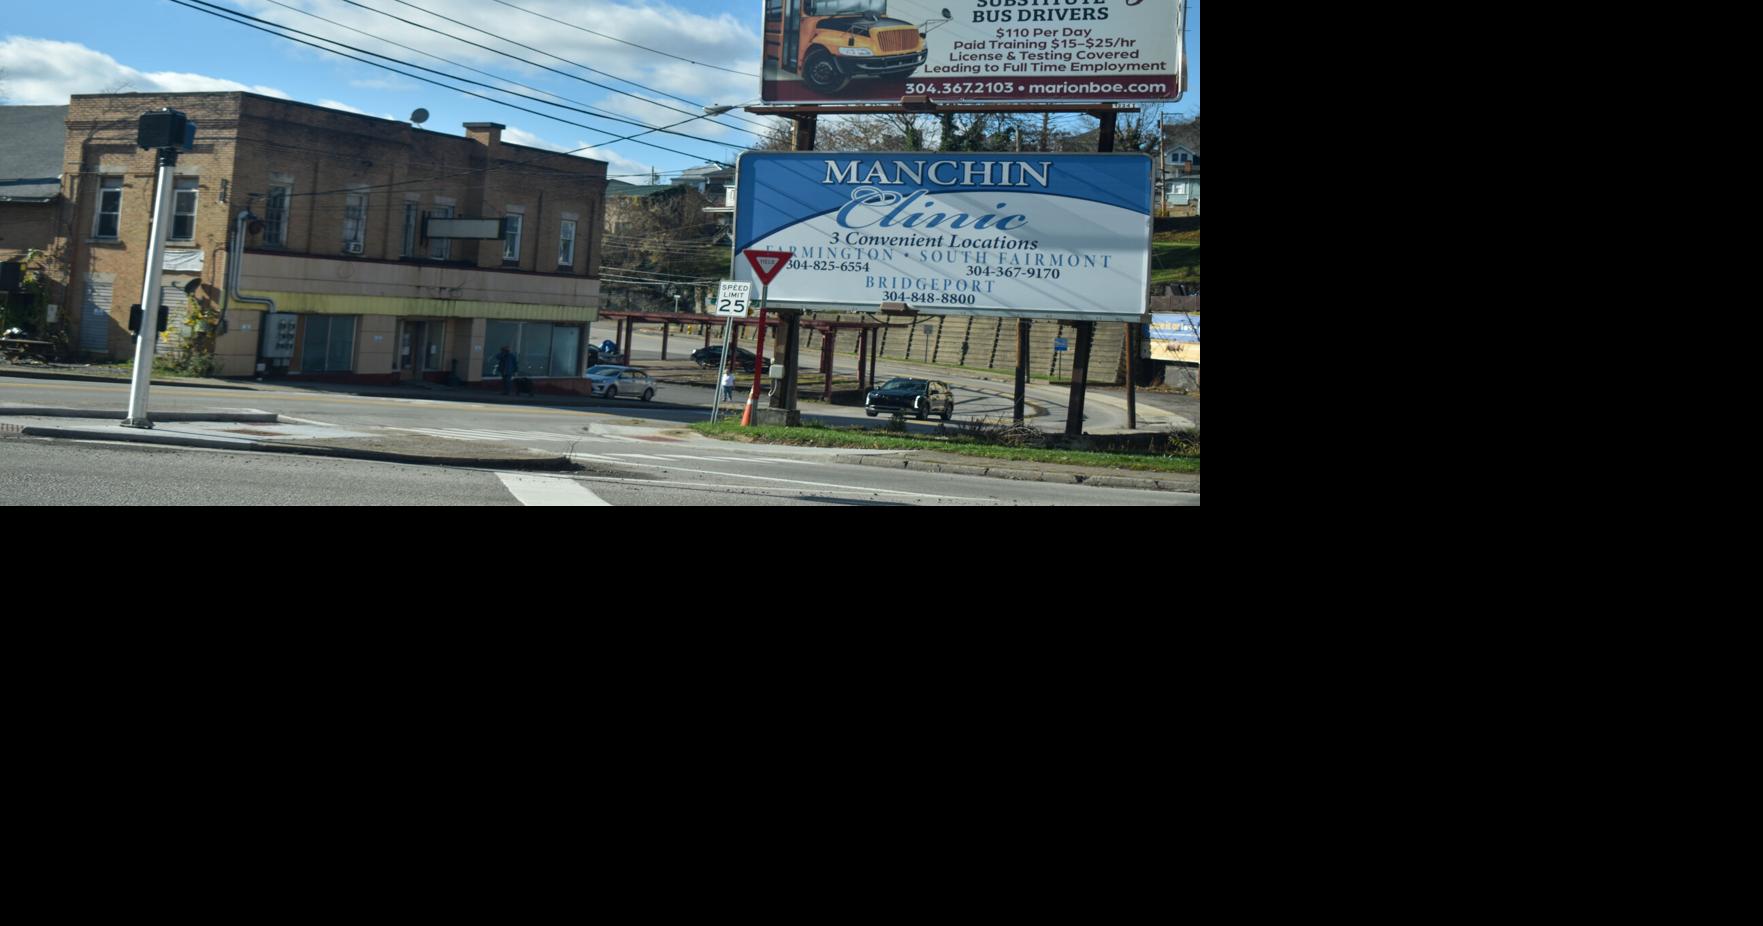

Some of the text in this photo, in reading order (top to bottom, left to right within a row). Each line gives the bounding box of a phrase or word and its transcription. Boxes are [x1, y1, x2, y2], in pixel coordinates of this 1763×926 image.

[972, 7, 1109, 23] BUS DRIVERS
[996, 27, 1092, 39] $110 Per Day
[954, 40, 986, 50] Paid
[989, 40, 1047, 51] Training
[949, 49, 1140, 62] License & Testing Covered
[924, 61, 1167, 74] Leading to Full Time Employment
[905, 80, 1167, 95] 304.367.2103 marionboe.com
[822, 160, 1052, 188] MANCHIN
[836, 186, 1029, 231] Clinic
[829, 232, 1039, 250] 3 Convenient Locations
[785, 259, 870, 273] 304-825-6554
[919, 250, 988, 265] SOUTH
[998, 253, 1113, 269] FAIRMONT
[965, 265, 1061, 280] 304-367-9170
[722, 284, 749, 292] SPEED
[865, 276, 996, 294] BRIDGEPORT
[882, 291, 976, 305] 304-848-8800
[719, 300, 745, 313] 25
